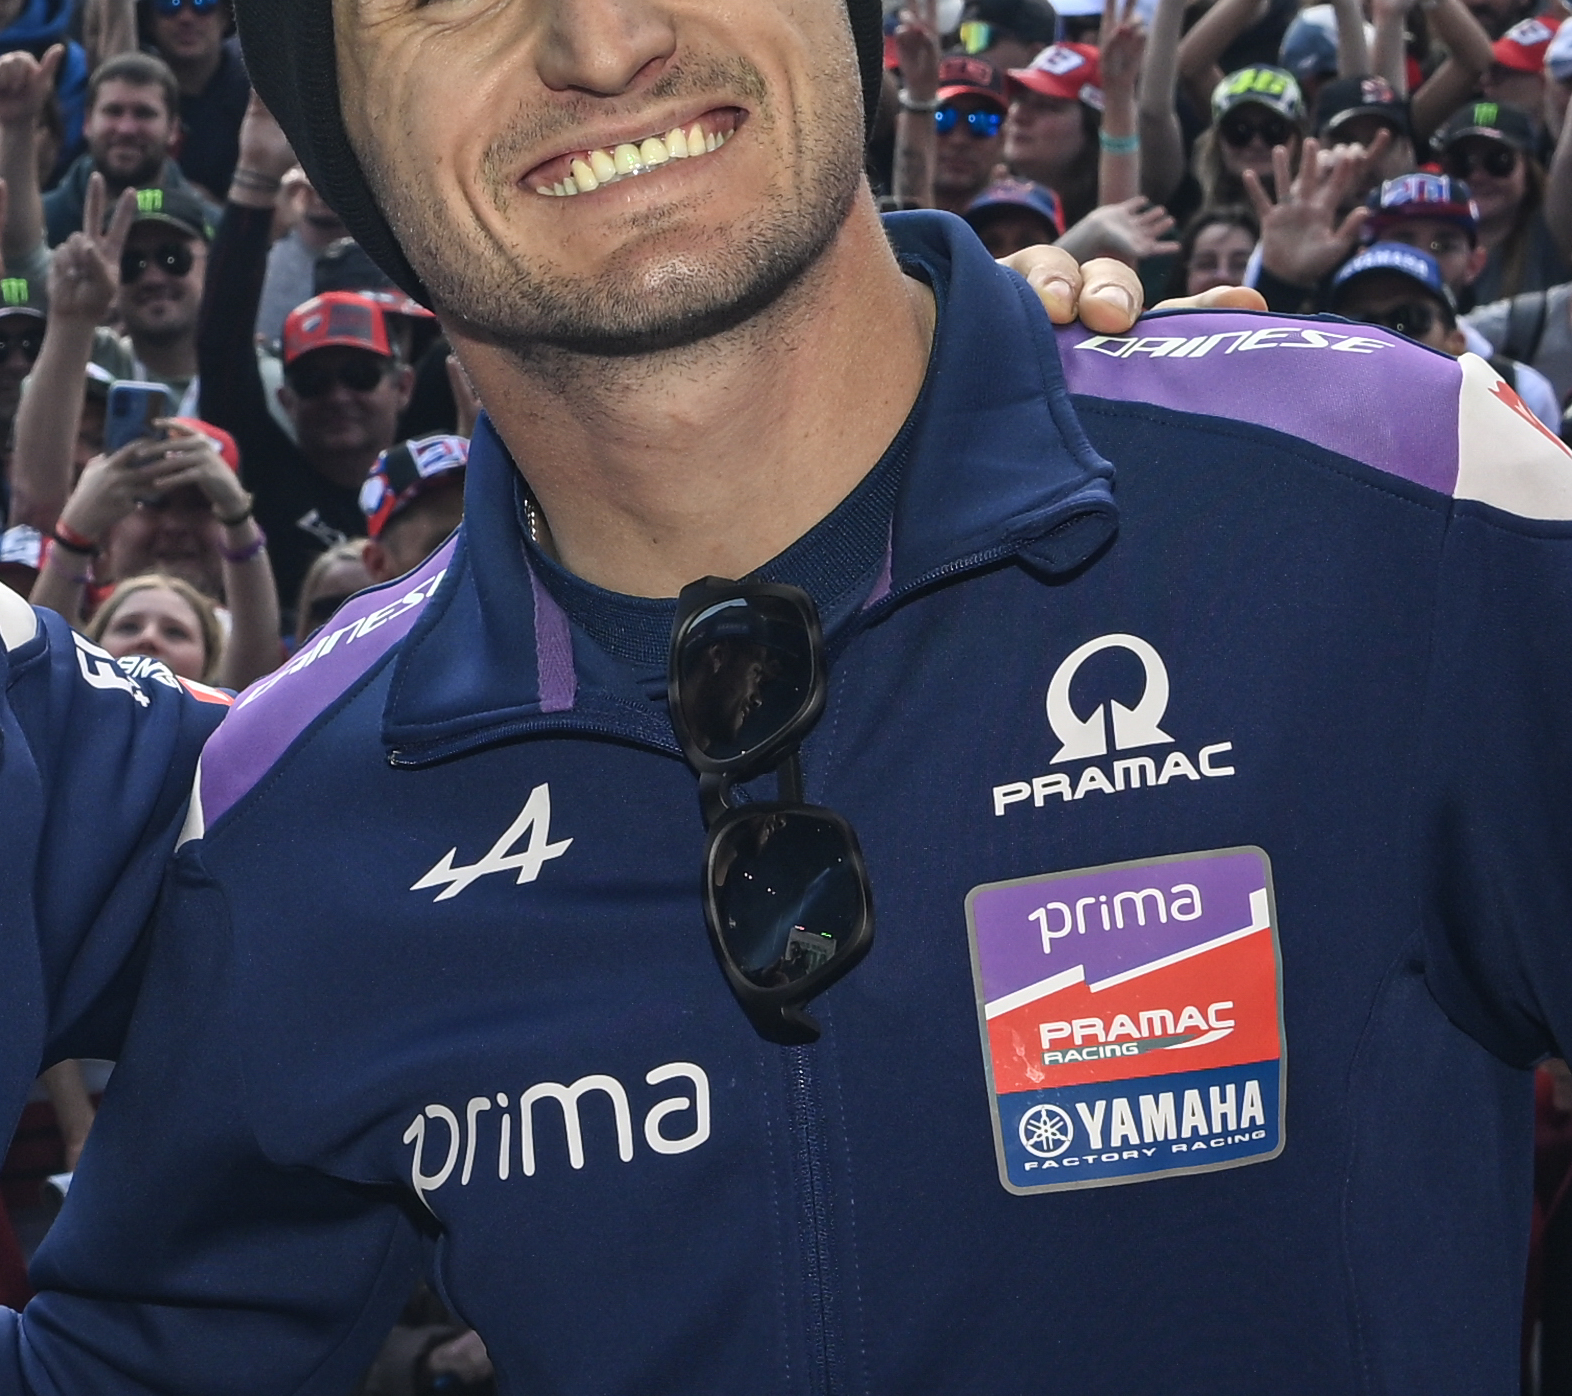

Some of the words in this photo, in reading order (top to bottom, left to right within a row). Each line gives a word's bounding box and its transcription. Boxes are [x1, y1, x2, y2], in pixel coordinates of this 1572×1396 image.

[1073, 326, 1396, 360] DAINESE
[993, 741, 1235, 816] PRAMAC
[1028, 881, 1204, 956] prima
[1038, 1001, 1236, 1050] PRAMAC
[1043, 1042, 1139, 1065] RACING
[1075, 1079, 1266, 1150] YAMAHA
[404, 1062, 711, 1228] prima
[1023, 1147, 1156, 1172] FACTORY
[1171, 1129, 1267, 1154] RACING
